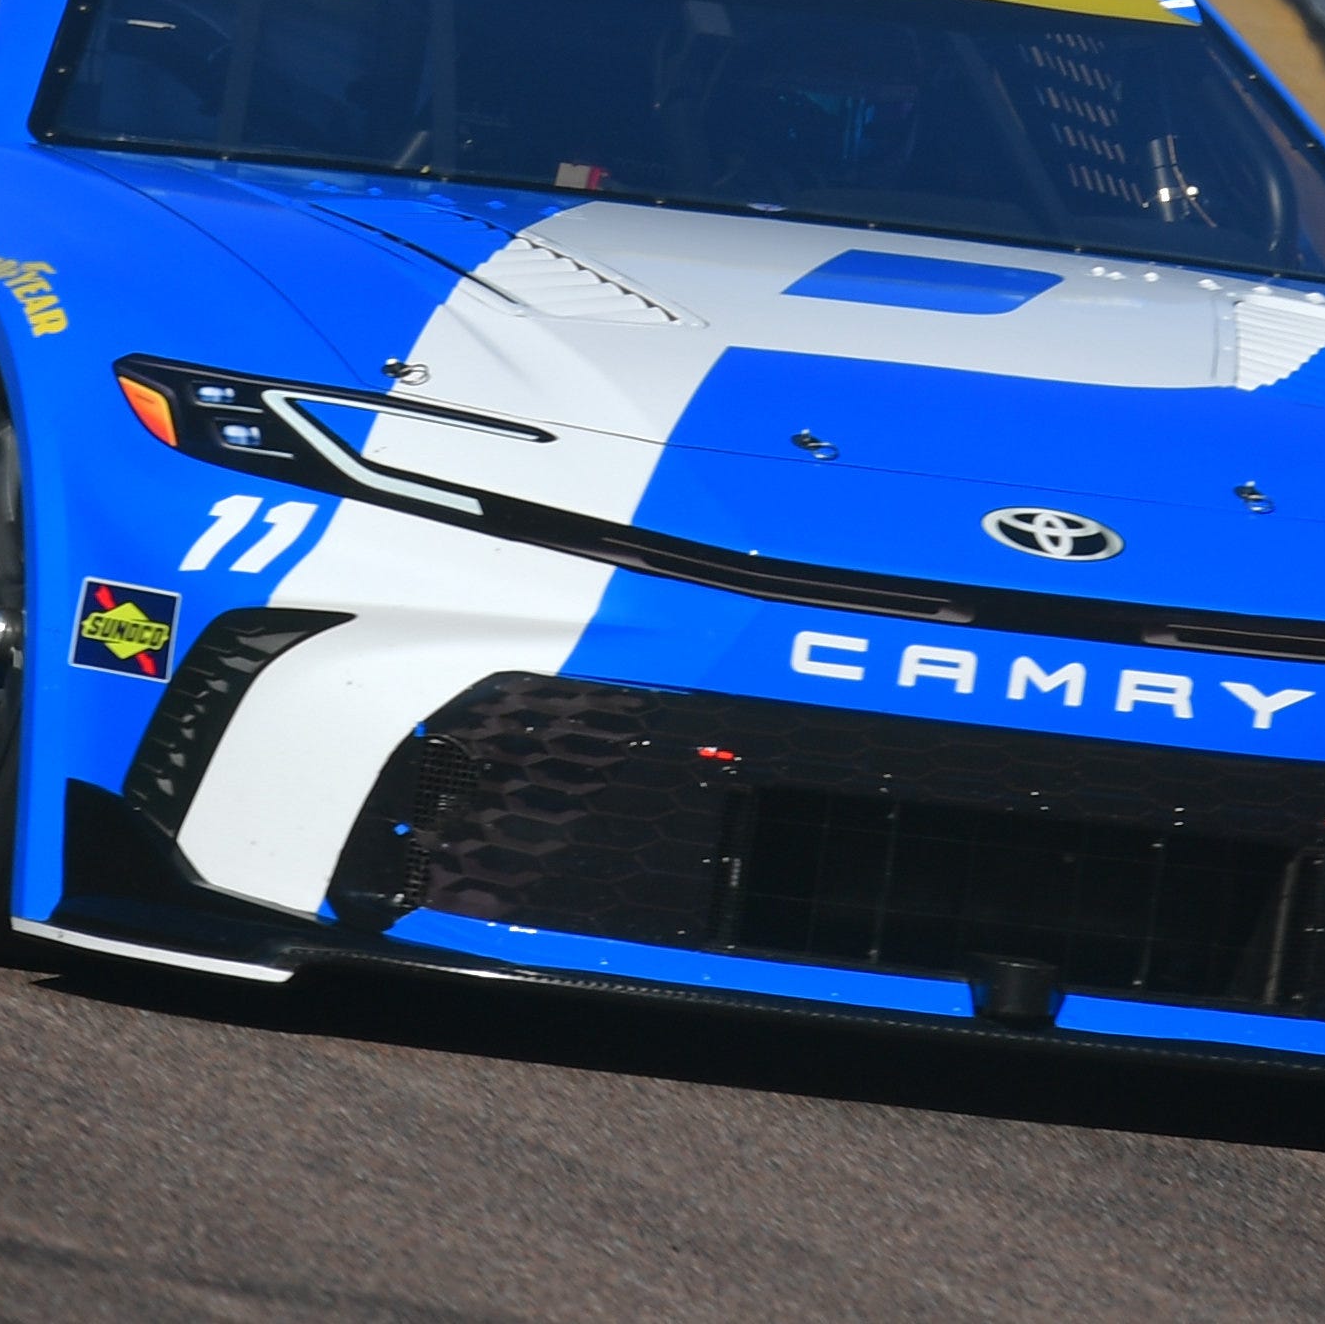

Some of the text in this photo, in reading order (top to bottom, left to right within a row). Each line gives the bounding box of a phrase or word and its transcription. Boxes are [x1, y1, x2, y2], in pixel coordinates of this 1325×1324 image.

[178, 494, 319, 573] 11
[86, 615, 166, 648] SUNOCO
[789, 630, 1317, 729] CAMRY
